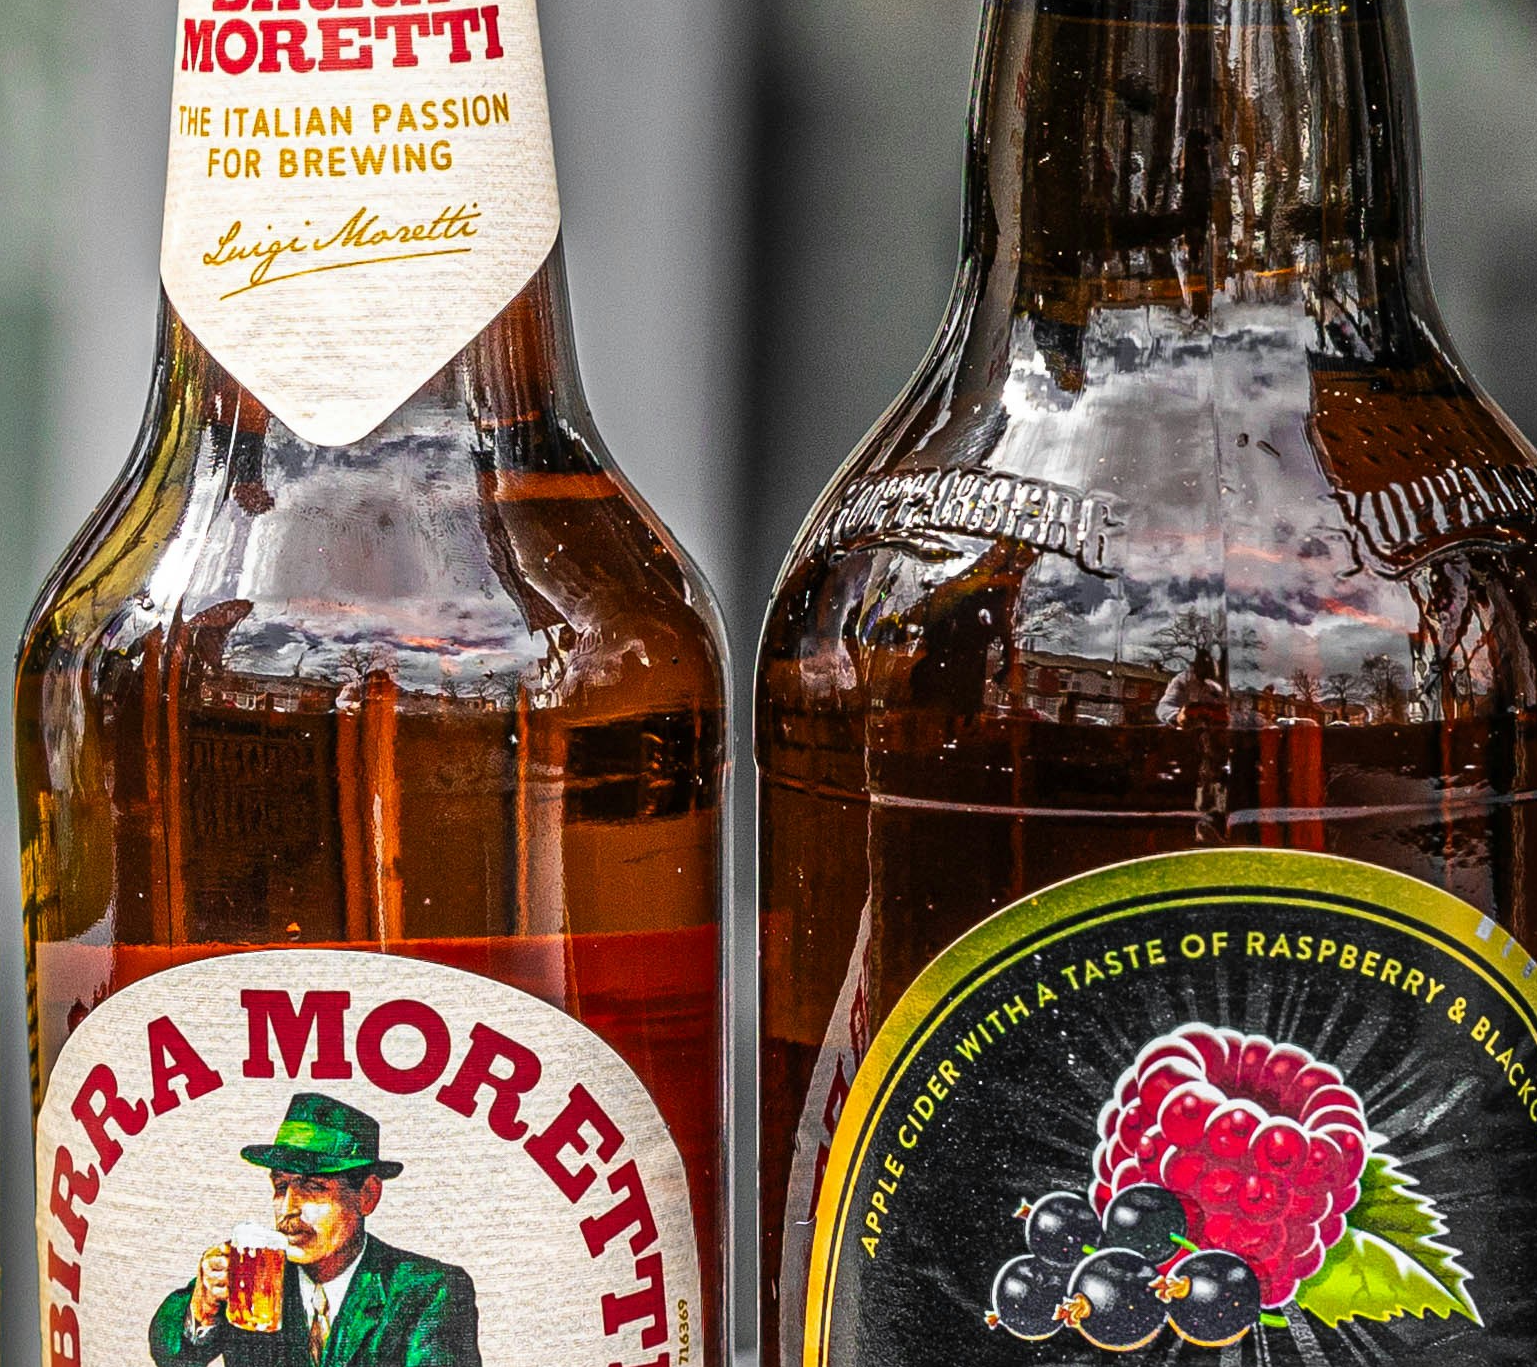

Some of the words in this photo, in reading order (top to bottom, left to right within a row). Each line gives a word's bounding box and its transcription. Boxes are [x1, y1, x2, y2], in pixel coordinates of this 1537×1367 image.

[181, 5, 505, 76] MORETTI
[178, 105, 211, 138] THE
[224, 105, 351, 137] ITALIAN
[373, 92, 510, 132] PASSION
[207, 147, 261, 178] FOR
[279, 139, 453, 178] BREWING
[202, 219, 310, 285] Luigi
[320, 203, 482, 253] Moretti
[862, 1152, 904, 1259] APPLE
[898, 1059, 963, 1149] CIDER
[954, 1000, 1031, 1062] WITH
[1036, 981, 1058, 1010] A
[1061, 937, 1166, 991] TASTE
[1181, 932, 1230, 961] OF
[1246, 930, 1446, 1006] RASPBERRY
[1447, 995, 1469, 1024] &
[678, 1299, 690, 1366] 716369
